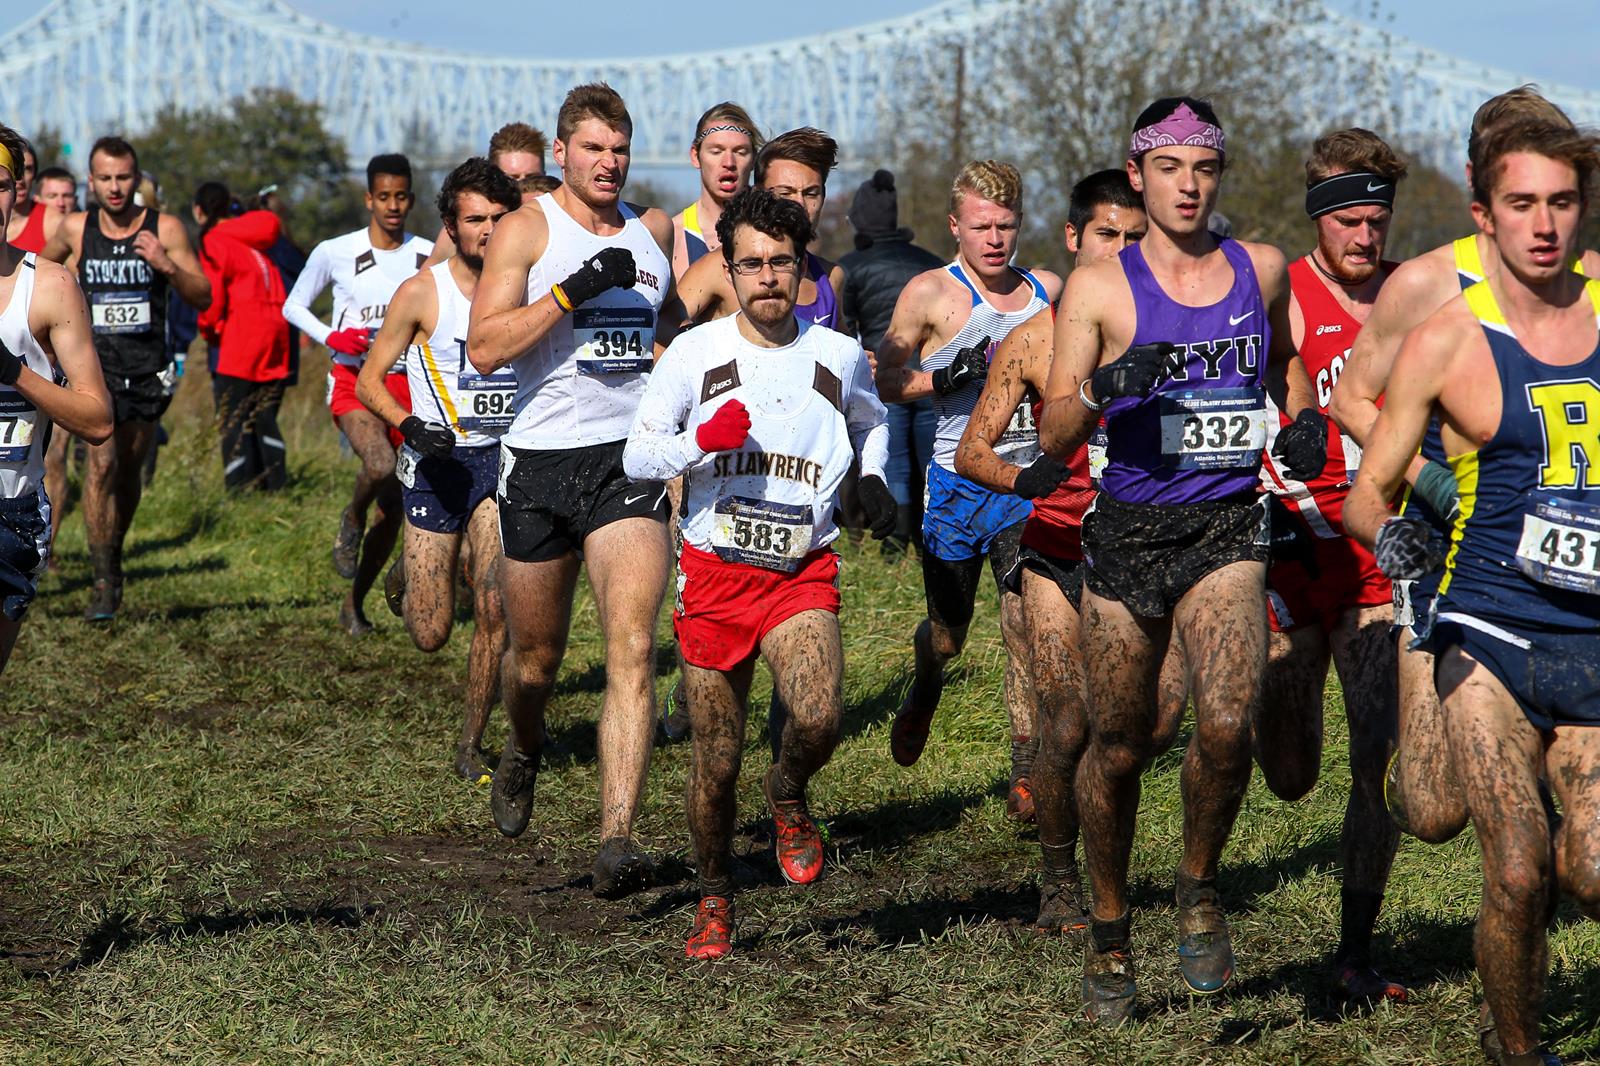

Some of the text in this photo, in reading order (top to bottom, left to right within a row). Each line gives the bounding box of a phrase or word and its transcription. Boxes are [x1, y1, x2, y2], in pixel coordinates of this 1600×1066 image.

[104, 306, 140, 323] 632
[593, 330, 643, 357] 394
[1155, 335, 1262, 381] NYU
[473, 392, 516, 415] 692
[1183, 415, 1251, 449] 332
[1524, 377, 1600, 490] R
[713, 451, 822, 489] ST. LAWRENCE
[1216, 454, 1242, 463] Regional
[733, 519, 792, 555] 583
[1541, 528, 1600, 572] 431
